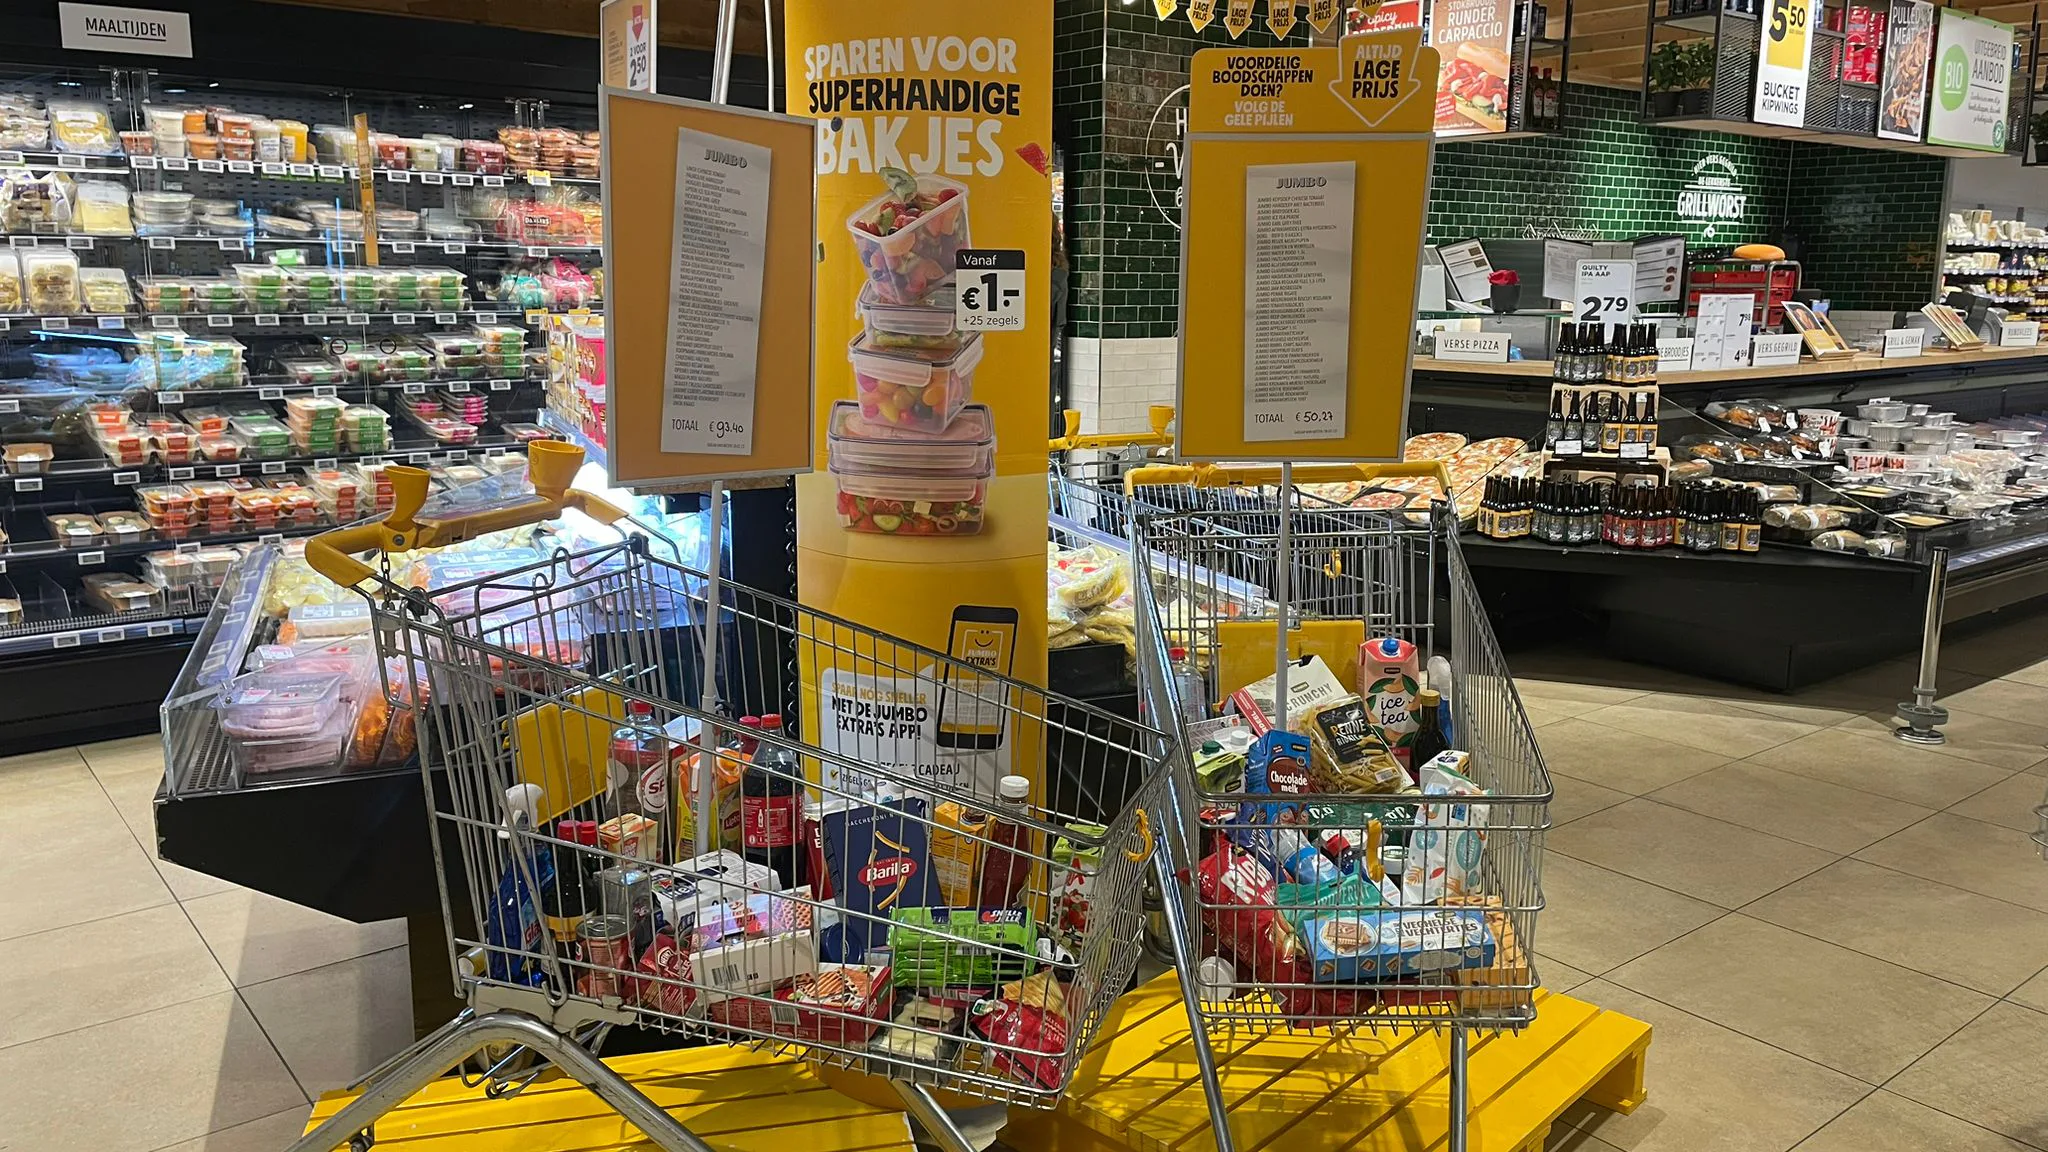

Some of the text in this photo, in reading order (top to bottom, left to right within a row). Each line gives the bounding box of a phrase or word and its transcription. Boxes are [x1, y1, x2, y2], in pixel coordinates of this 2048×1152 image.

[1448, 7, 1495, 26] RUNDER
[85, 16, 167, 38] MAALTIJDEN
[1438, 22, 1503, 44] CARPACCIO
[804, 36, 1017, 81] SPAREN VOOR
[1356, 45, 1402, 59] ALTIJD
[1227, 56, 1300, 70] VOORDELIG
[1353, 60, 1400, 80] LAGE
[1972, 58, 2005, 84] AANBOD
[1212, 69, 1313, 83] BOODSCHAPPEN
[1944, 60, 1964, 89] BIO
[809, 78, 1020, 116] SUPERHANDIGE
[1240, 84, 1283, 98] DOEN?
[1352, 80, 1399, 98] PRIJS
[1763, 82, 1800, 100] BUCKET
[1234, 101, 1285, 113] VOLG DE
[1761, 98, 1798, 114] KIPWINGS
[1224, 114, 1294, 126] GELE PIJLEN
[817, 116, 1005, 177] BAKJES
[704, 148, 748, 169] JUMBO
[1276, 176, 1327, 189] JUMBO
[1677, 191, 1747, 218] GRILLWORST
[963, 254, 997, 266] Vanaf
[963, 316, 1019, 327] +25 zegels
[1444, 339, 1499, 350] VERSE PIZZA
[1774, 342, 1798, 352] GEGRILD
[1563, 389, 1572, 397] 24
[672, 418, 699, 431] TOTAAL
[1255, 413, 1285, 424] TOTAAL
[966, 656, 996, 666] EXTRA'S
[1286, 682, 1333, 712] CRUNCHY
[1380, 697, 1405, 710] ice
[857, 702, 871, 718] DE
[873, 704, 928, 722] JUMBO
[1380, 710, 1409, 726] tea
[837, 715, 921, 740] EXTRA'S APP!
[1330, 718, 1367, 737] PENNE
[918, 763, 960, 776] CADEAU
[1270, 770, 1308, 786] Chocolade
[1281, 783, 1299, 794] melk
